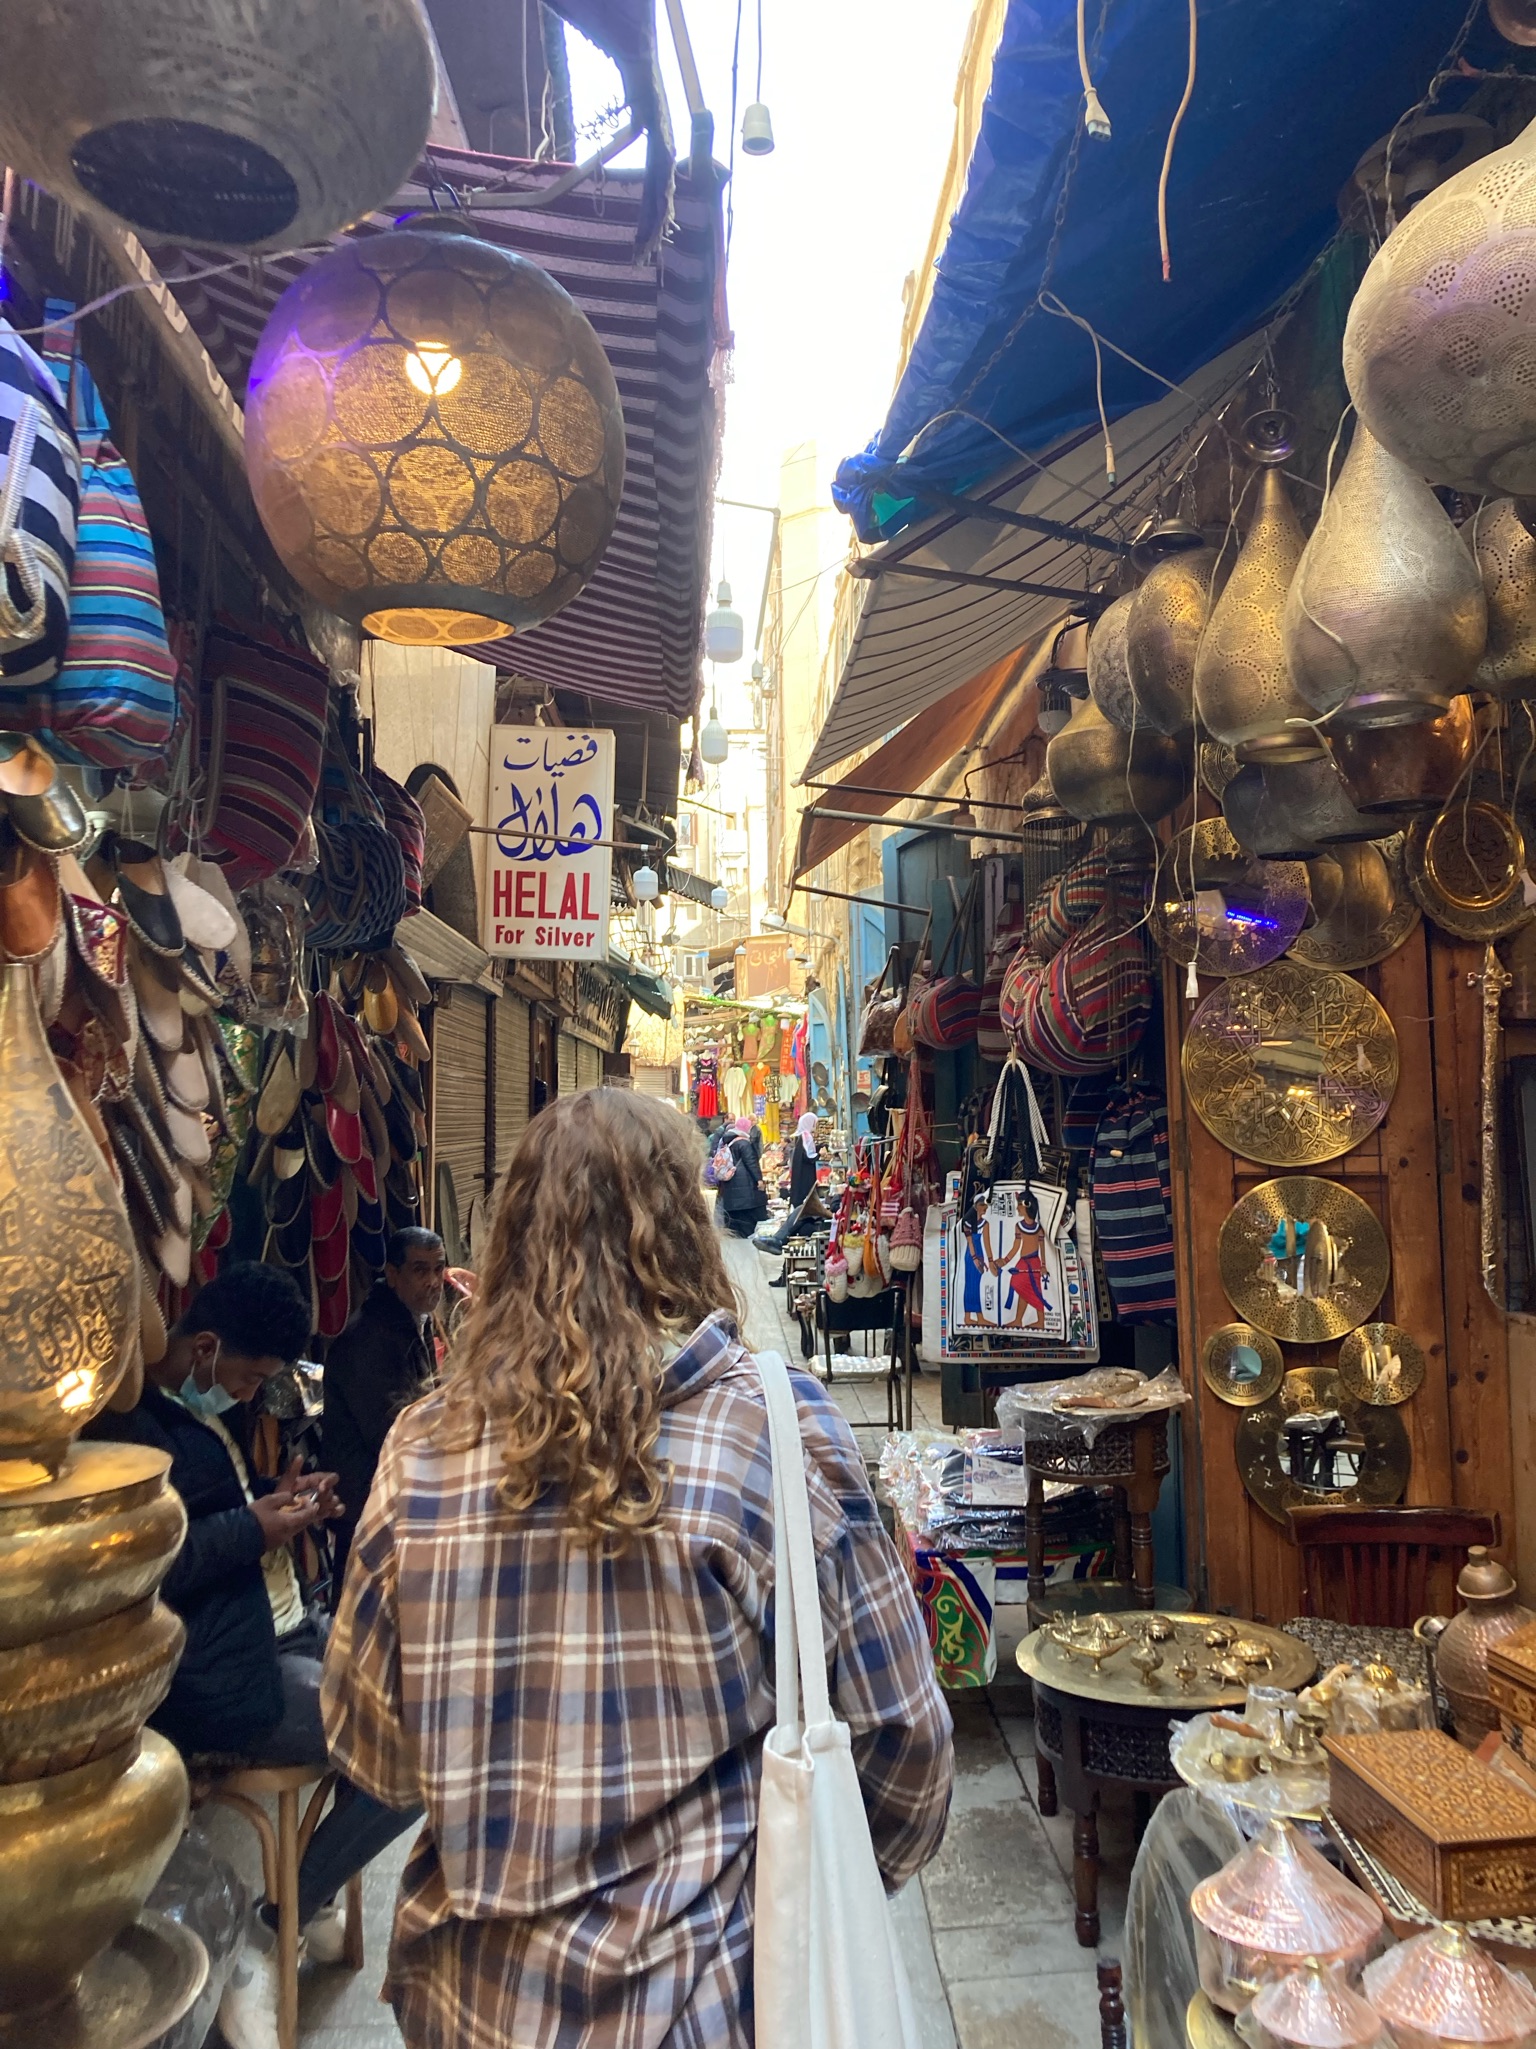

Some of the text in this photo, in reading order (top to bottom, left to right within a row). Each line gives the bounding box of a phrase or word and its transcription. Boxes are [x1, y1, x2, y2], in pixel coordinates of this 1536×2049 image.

[503, 734, 598, 778] فضيات
[496, 781, 603, 862] هلال
[493, 869, 600, 921] HELAL
[495, 925, 595, 947] For Silver
